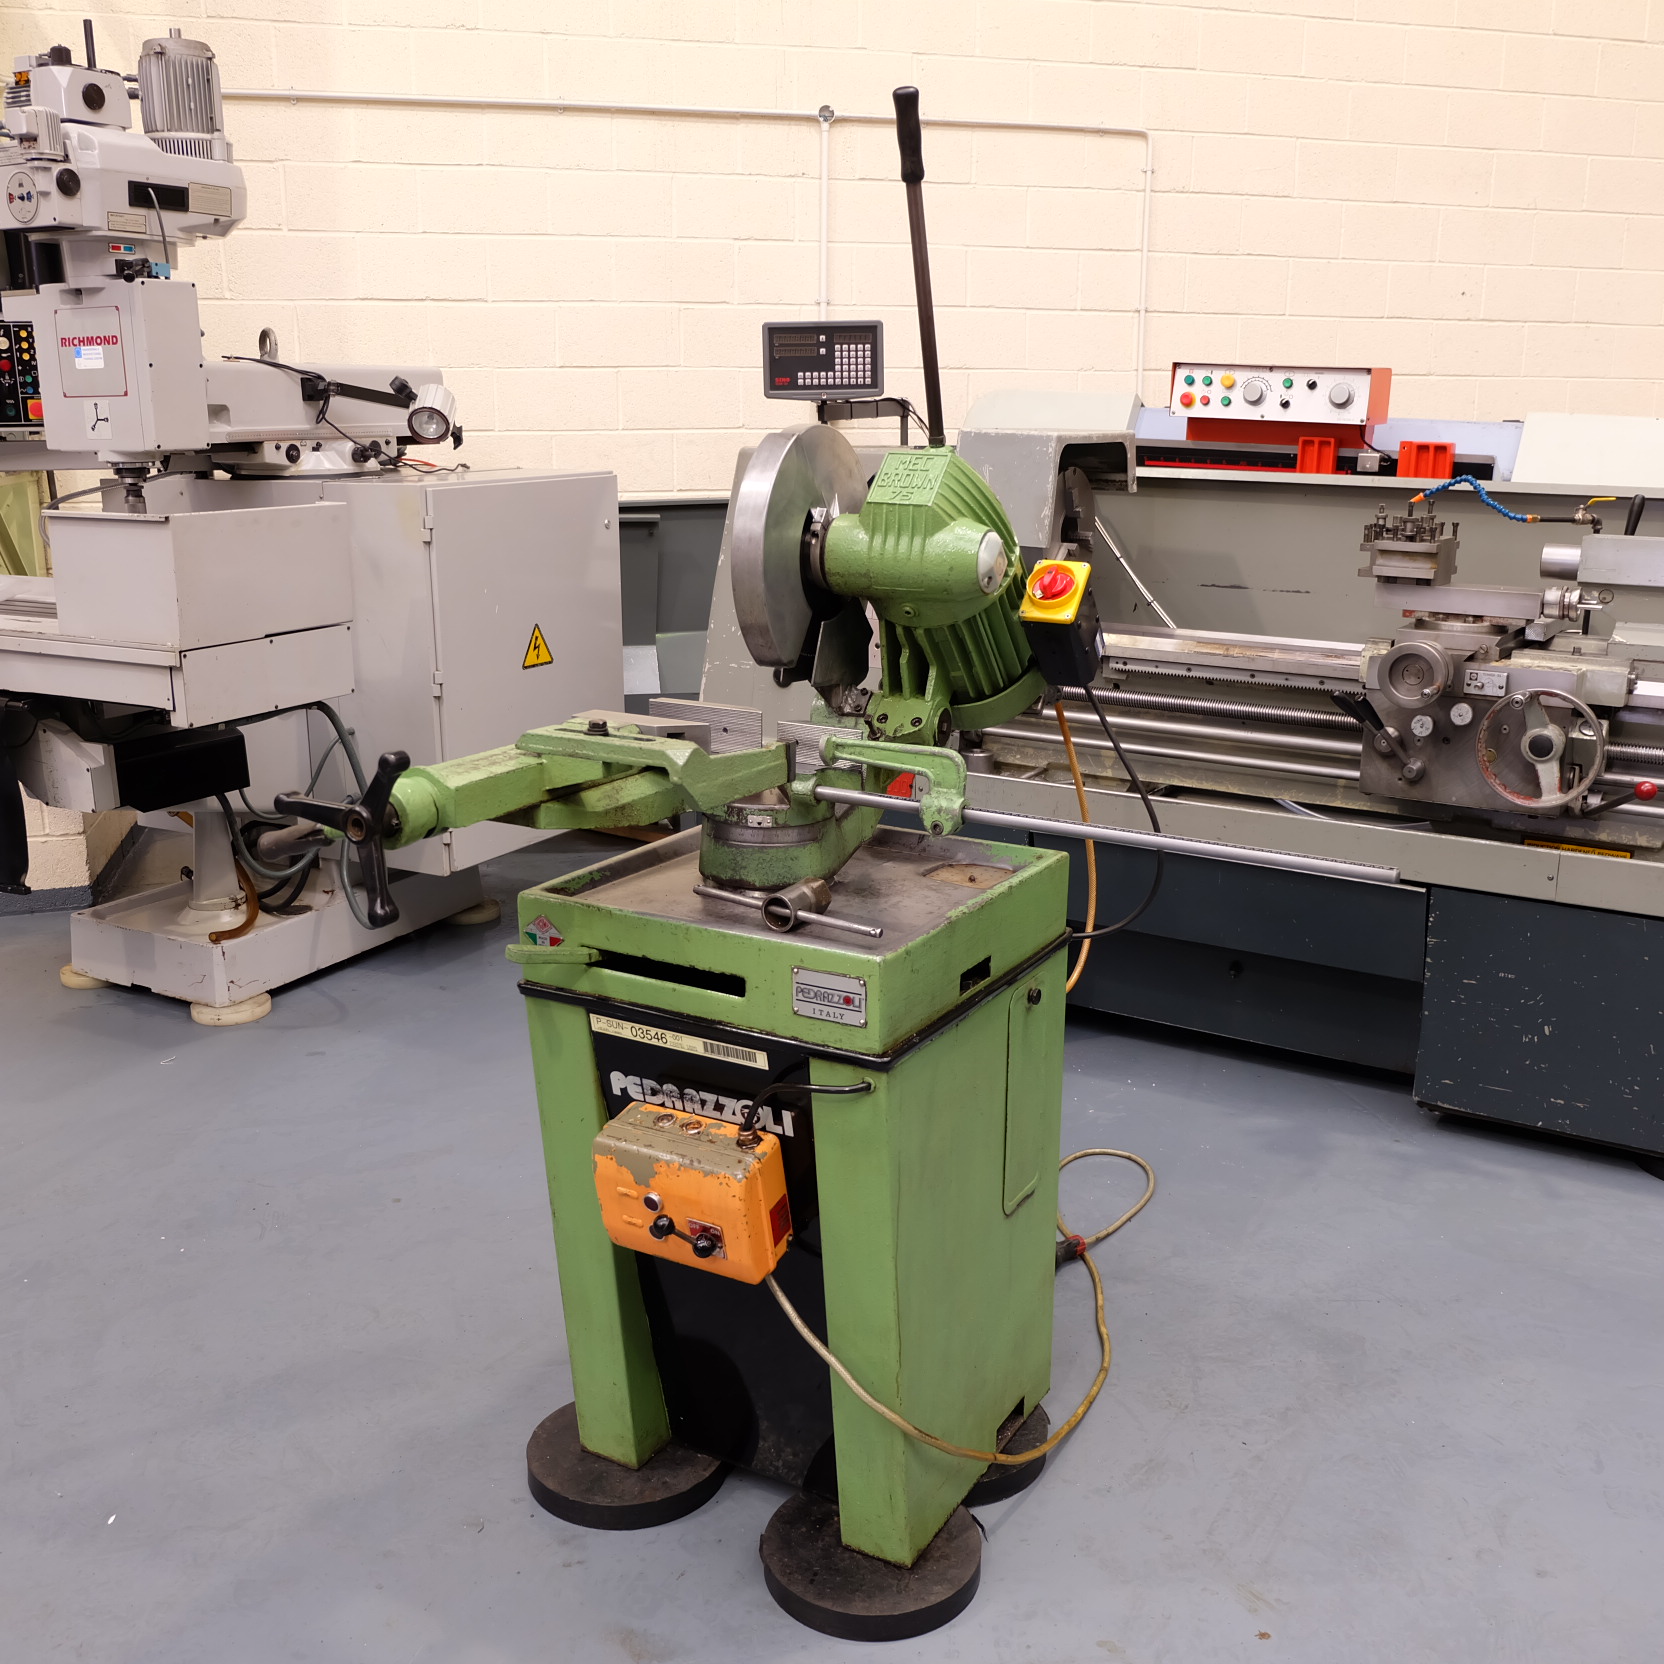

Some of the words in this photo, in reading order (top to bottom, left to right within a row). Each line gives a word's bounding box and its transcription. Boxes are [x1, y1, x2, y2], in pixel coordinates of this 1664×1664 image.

[60, 335, 119, 347] RICHMOND
[895, 456, 934, 471] MEC
[877, 472, 938, 490] BROWN
[891, 491, 914, 500] 75
[795, 985, 862, 1009] PEDRAZZOLI
[812, 1008, 845, 1020] ITALY
[630, 1025, 668, 1044] 03546
[610, 1070, 795, 1137] PEDRAZZOLI
